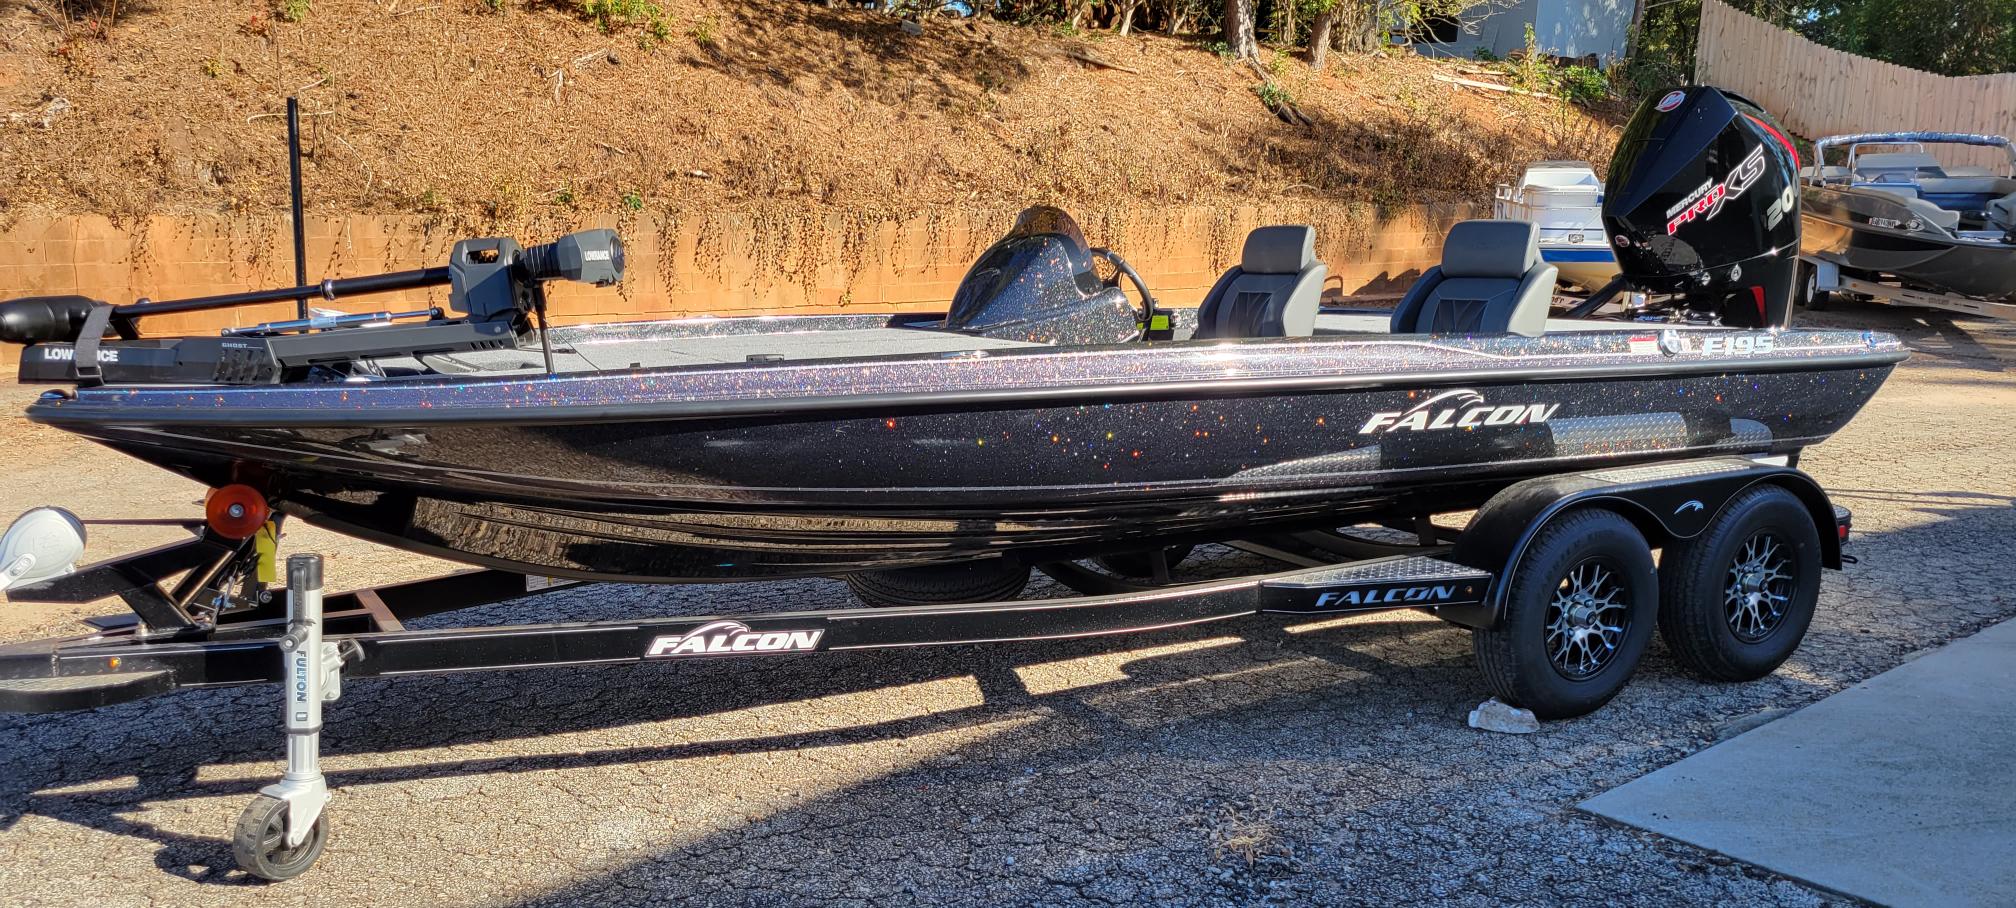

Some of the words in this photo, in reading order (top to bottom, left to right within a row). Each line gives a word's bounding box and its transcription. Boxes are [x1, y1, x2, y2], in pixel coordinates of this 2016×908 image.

[1666, 177, 1713, 219] MERCURY
[584, 250, 610, 261] LOWRANCE
[44, 347, 118, 362] LOWCE
[1358, 403, 1560, 434] FALCON
[1315, 585, 1456, 607] FALCON
[648, 630, 822, 655] FALCON
[296, 650, 307, 702] FULTON
